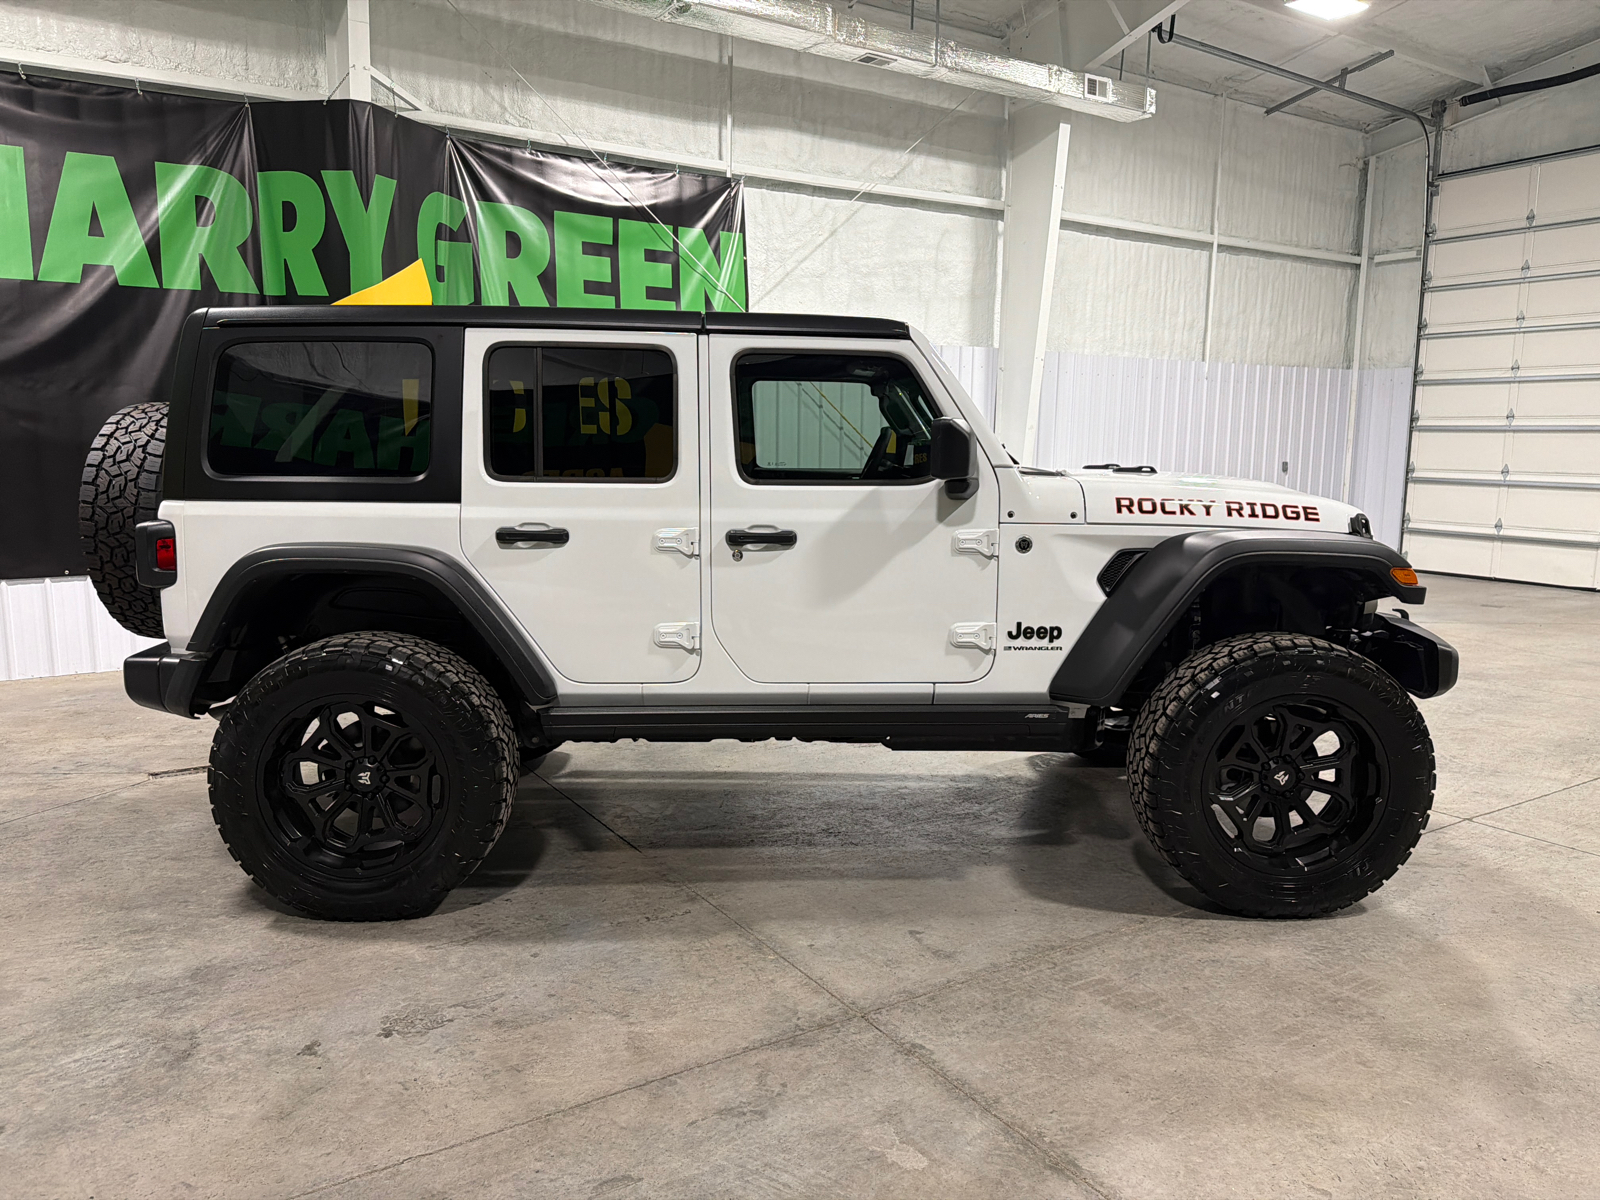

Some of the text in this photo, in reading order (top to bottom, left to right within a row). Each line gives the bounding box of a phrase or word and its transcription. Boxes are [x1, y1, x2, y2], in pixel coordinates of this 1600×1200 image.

[416, 191, 748, 313] GREEN
[1115, 497, 1321, 523] ROCKY RIDGE
[1007, 621, 1063, 644] Jeep
